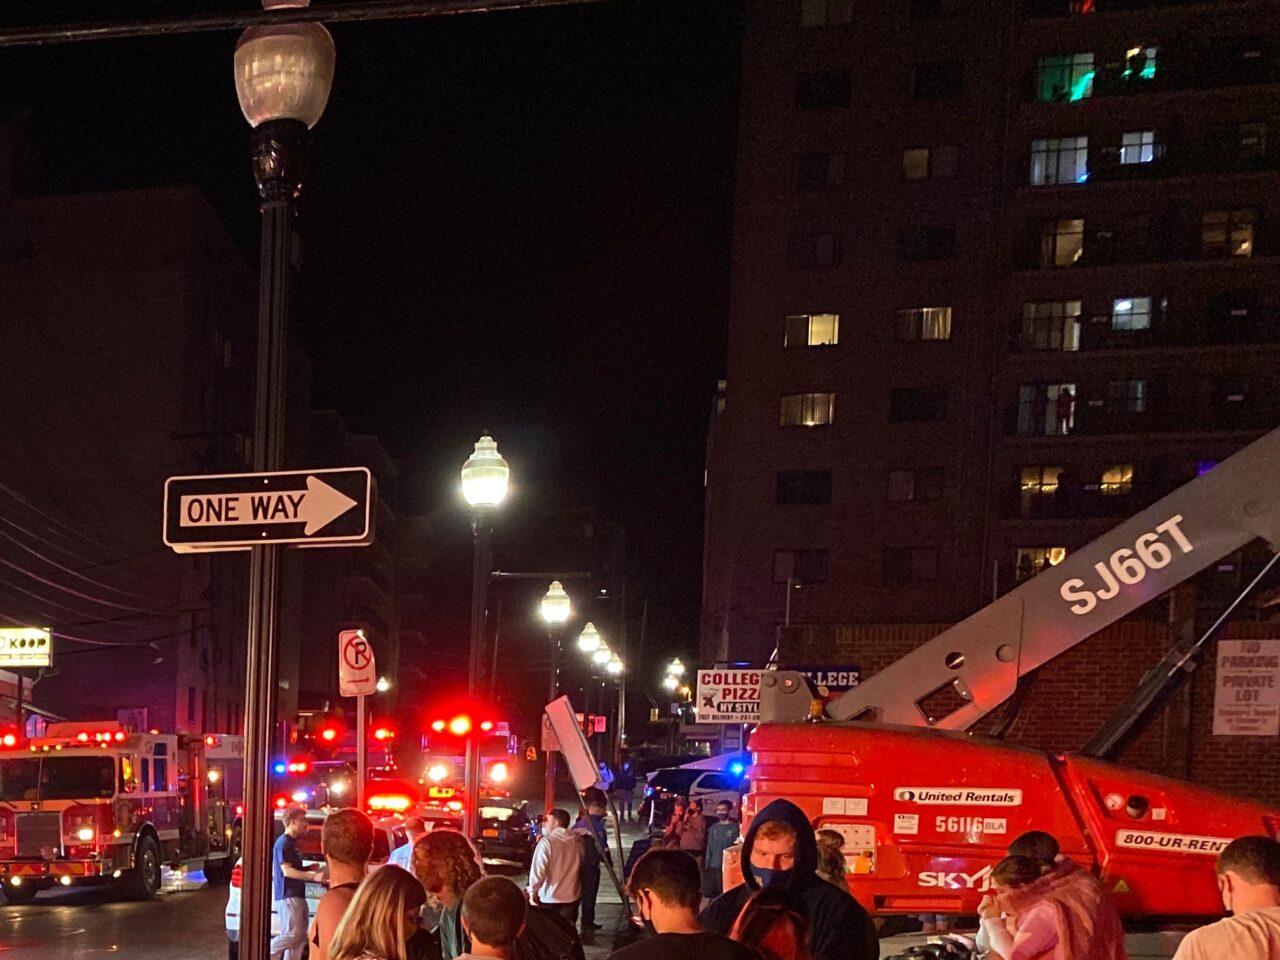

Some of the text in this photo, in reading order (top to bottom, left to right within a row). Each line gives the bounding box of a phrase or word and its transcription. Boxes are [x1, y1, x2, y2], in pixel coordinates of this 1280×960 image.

[187, 493, 306, 523] ONE WAY
[1060, 514, 1194, 615] SJ66T
[9, 638, 46, 649] KOOP
[701, 673, 761, 686] COLLEG
[800, 671, 859, 686] LEGE
[1223, 675, 1275, 688] PRIVATE
[1235, 689, 1260, 701] LOT
[735, 702, 760, 713] STYL
[918, 791, 1015, 803] United Rentals
[984, 821, 1005, 831] BLA
[918, 864, 994, 892] SKYJ
